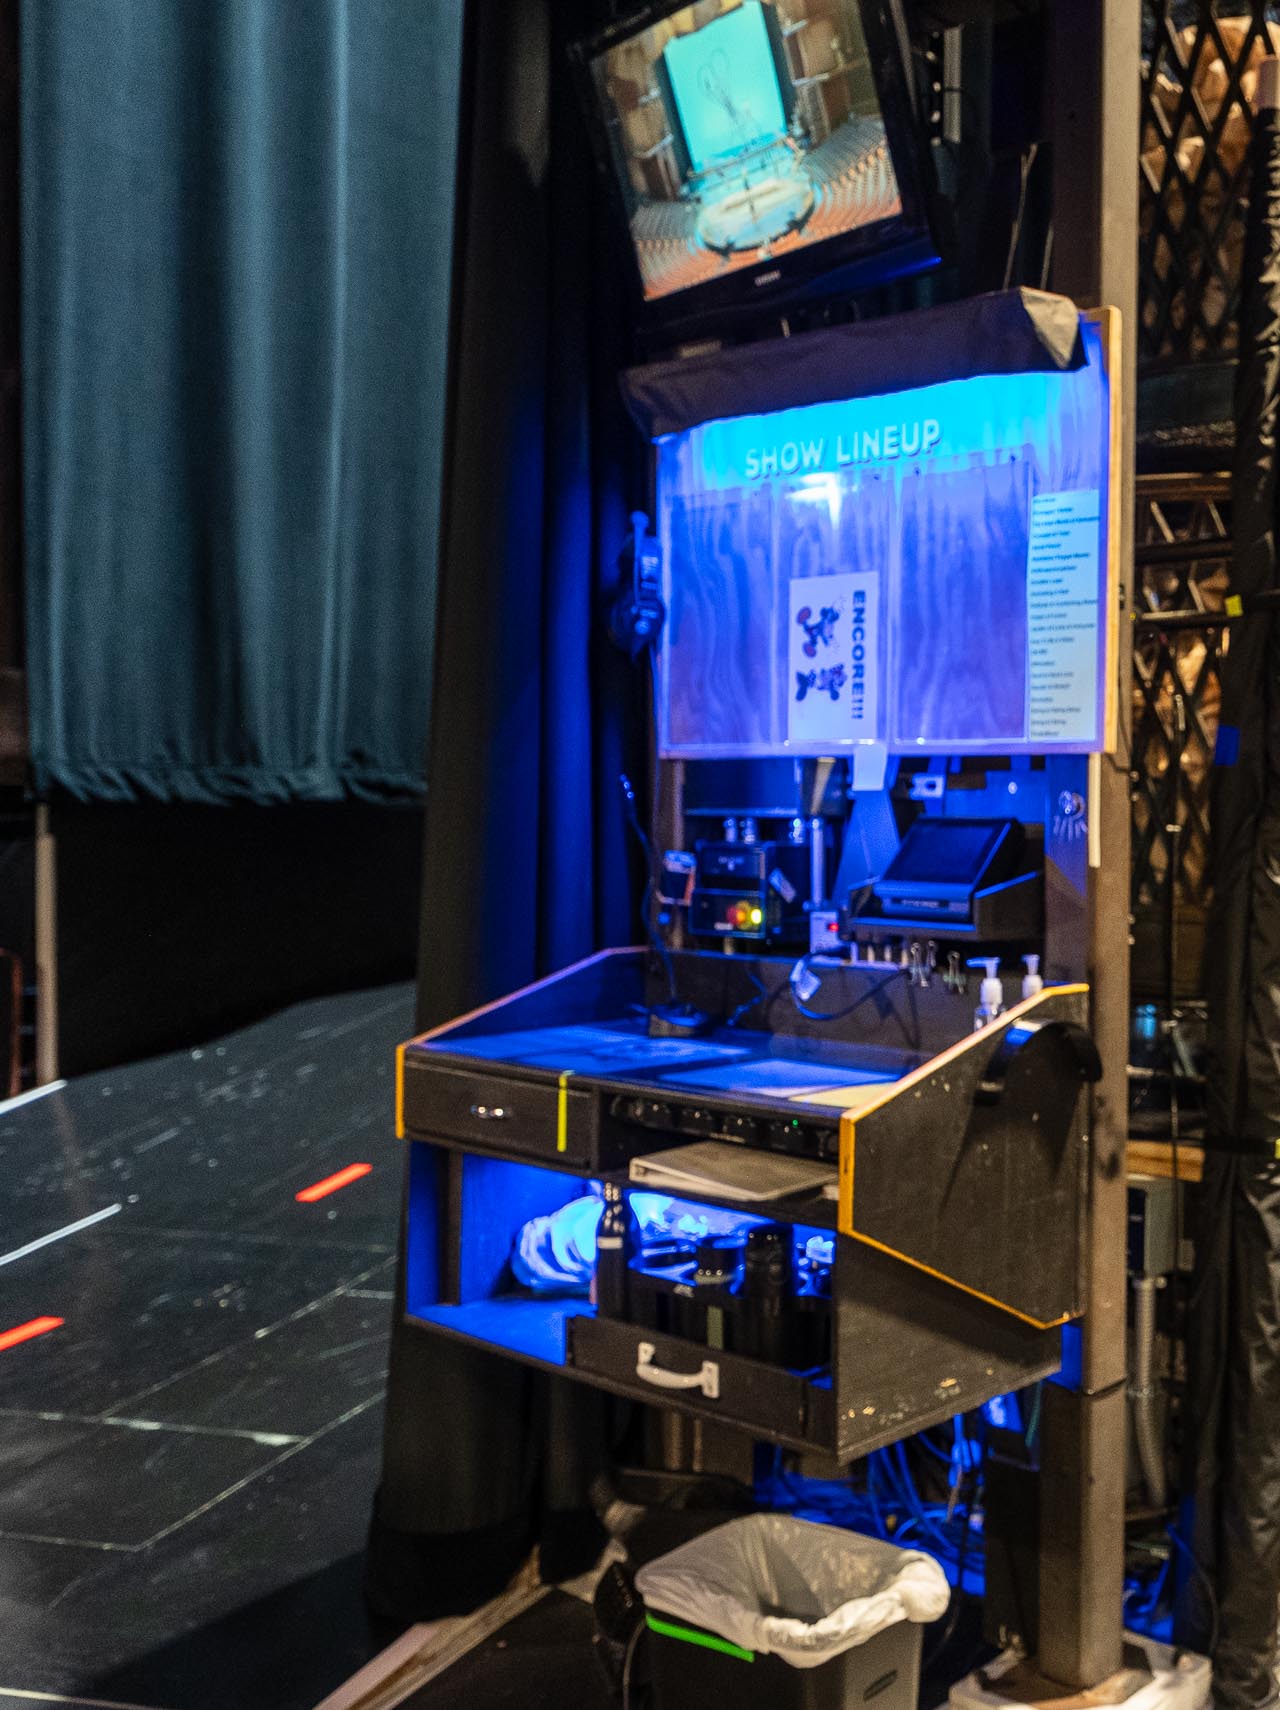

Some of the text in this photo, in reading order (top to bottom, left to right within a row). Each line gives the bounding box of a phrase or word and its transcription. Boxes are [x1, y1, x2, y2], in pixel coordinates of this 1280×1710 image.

[745, 419, 941, 479] SHOW LINEUP
[852, 590, 866, 719] ENCORE!!!
